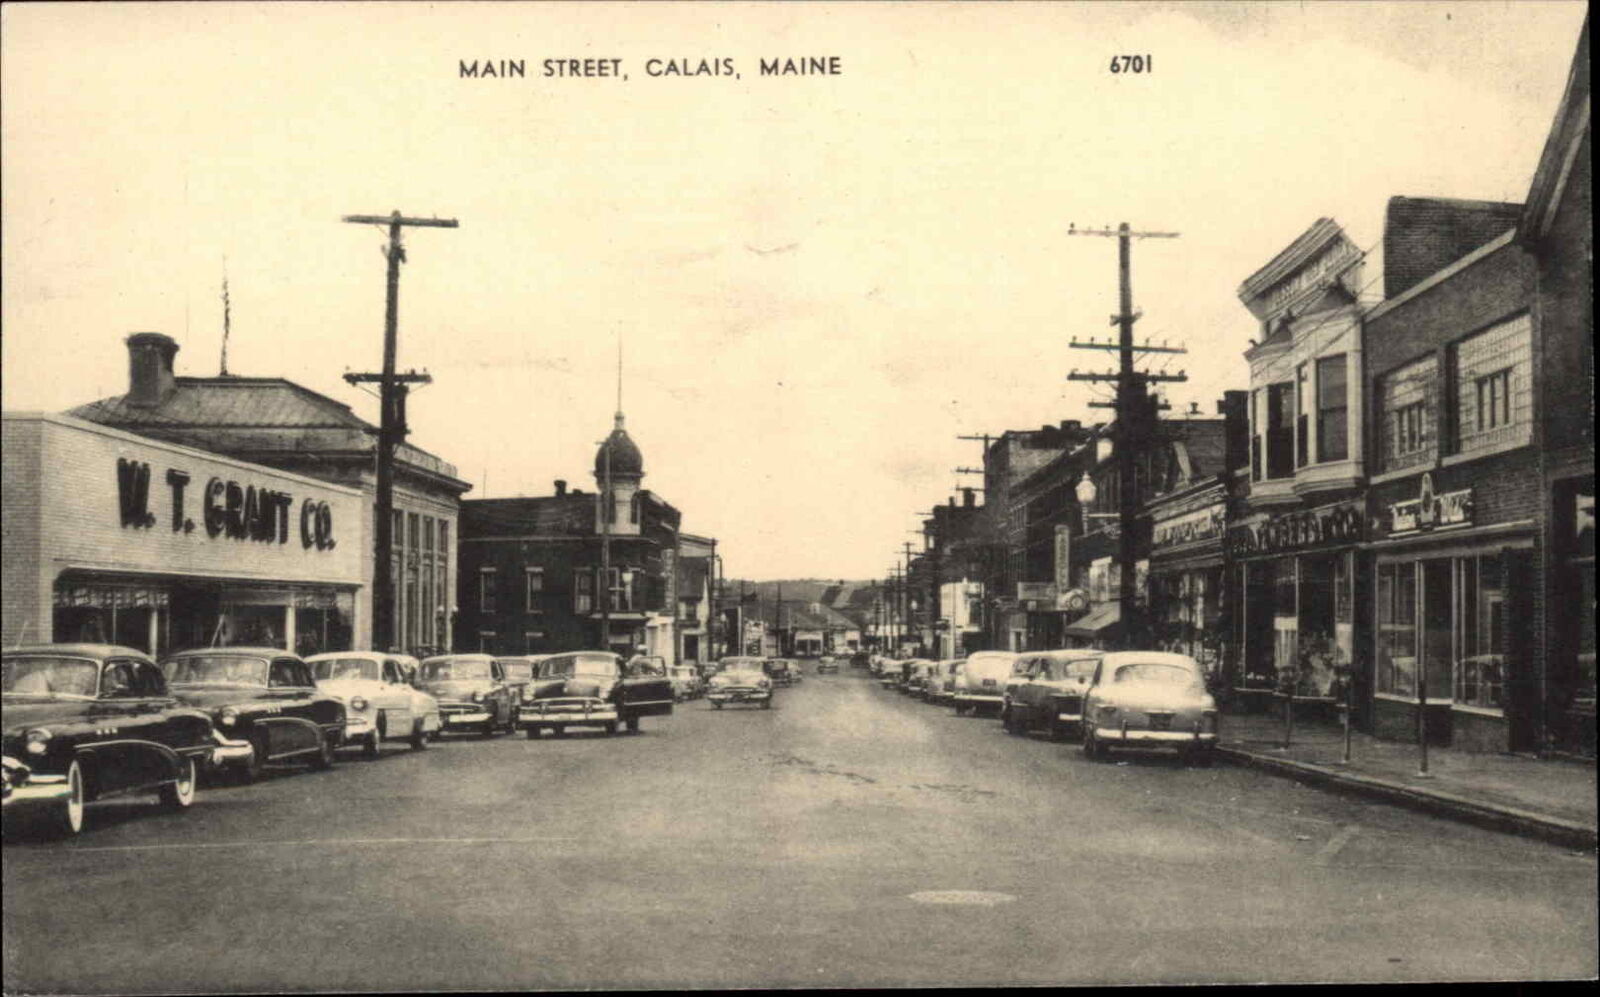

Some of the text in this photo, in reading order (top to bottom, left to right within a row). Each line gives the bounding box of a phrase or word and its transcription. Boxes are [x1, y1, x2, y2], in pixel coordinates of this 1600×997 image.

[117, 457, 337, 551] W. T. GRANT CO.
